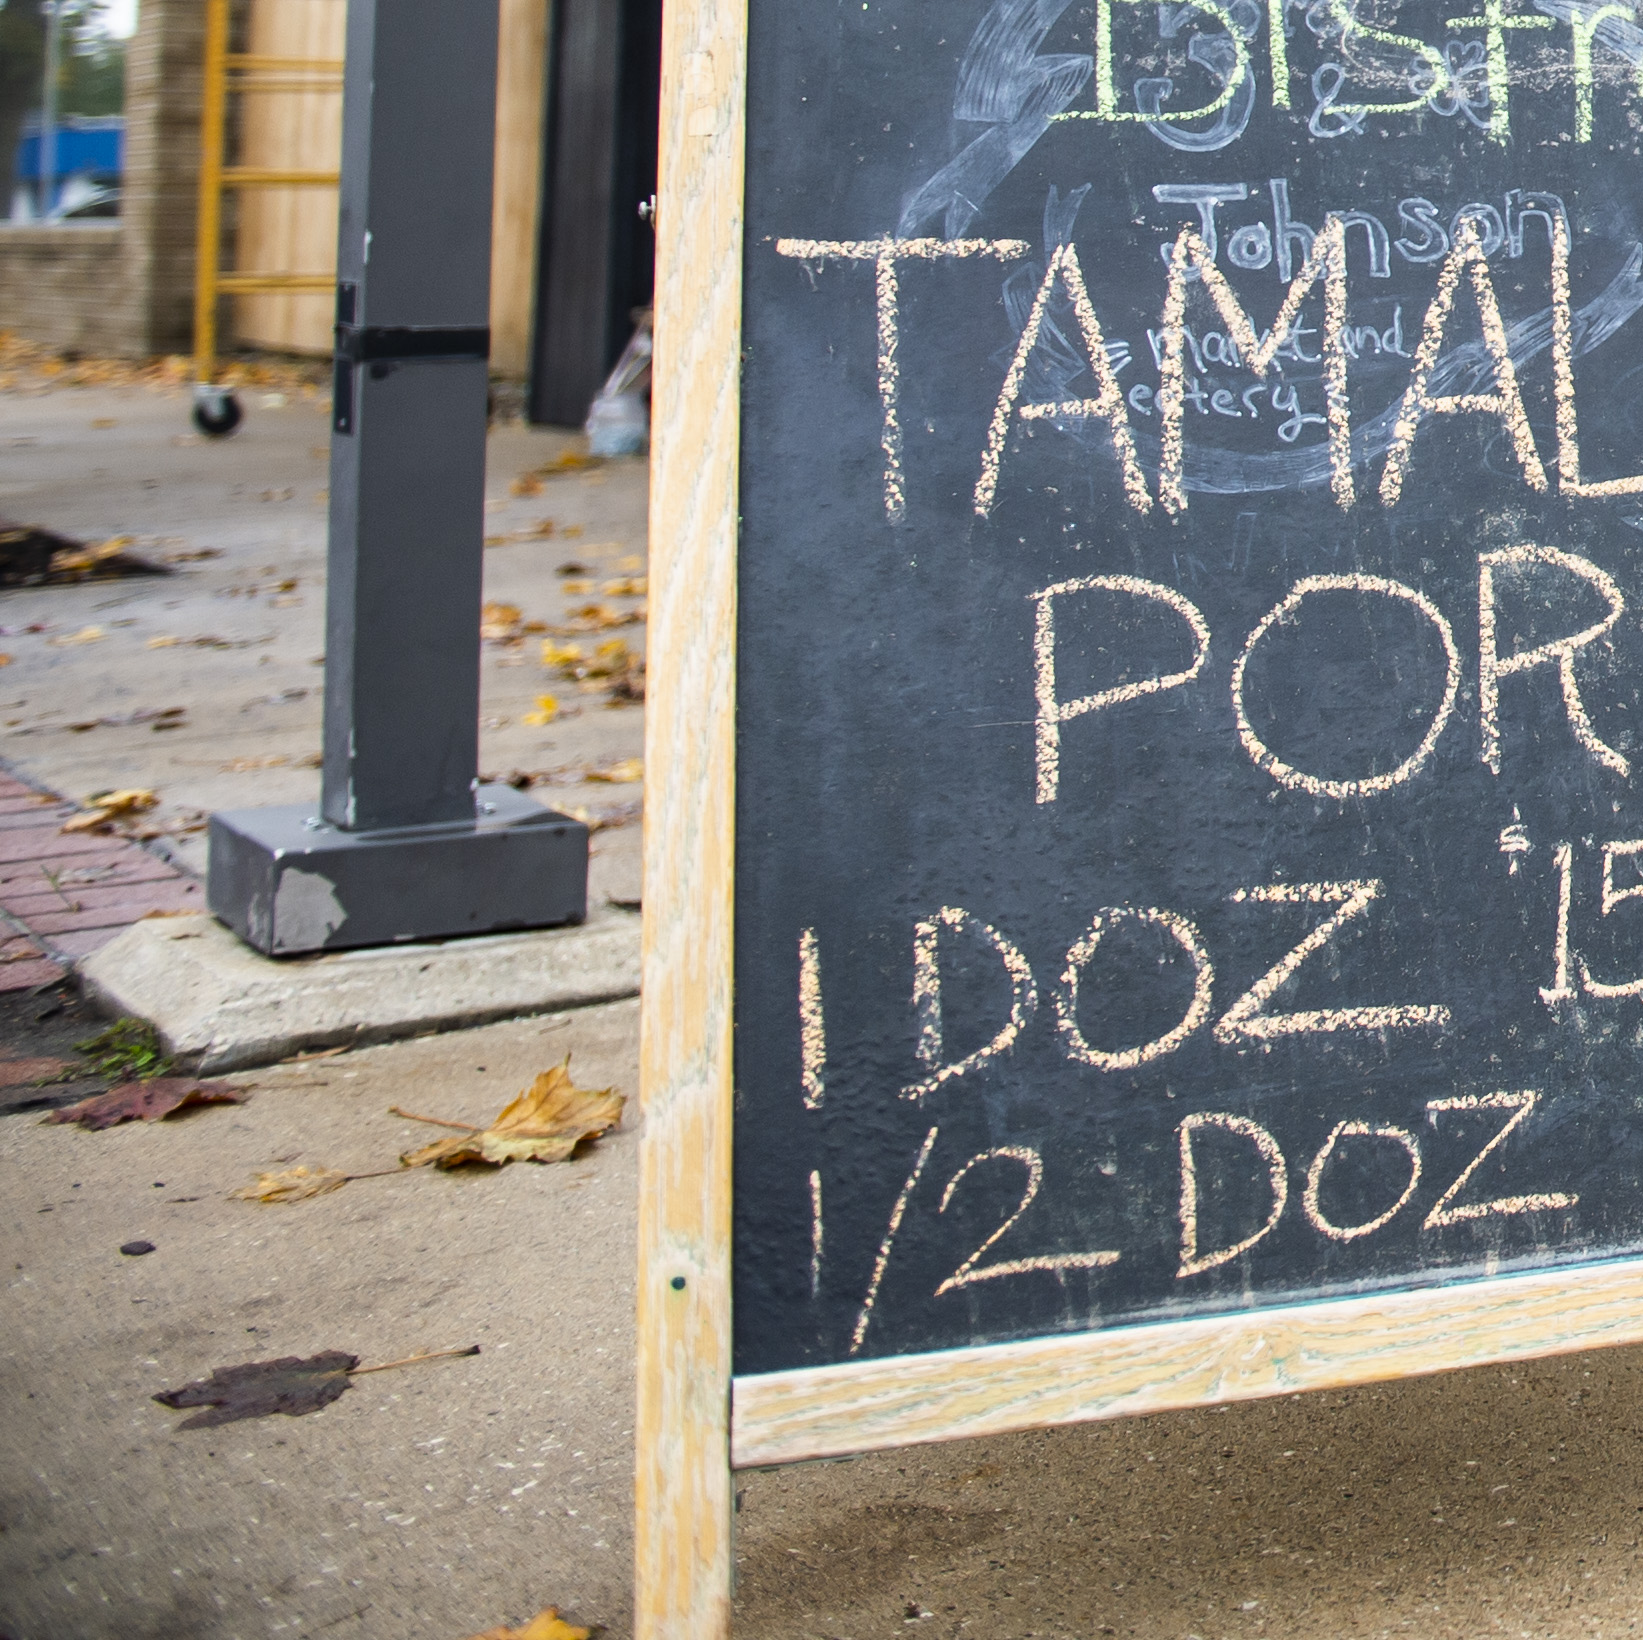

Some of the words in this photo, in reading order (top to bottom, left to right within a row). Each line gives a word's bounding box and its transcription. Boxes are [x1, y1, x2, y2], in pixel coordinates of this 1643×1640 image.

[1152, 177, 1572, 285] Johnson
[897, 877, 1453, 1104] DOZ
[810, 1124, 1123, 1357] 1/2
[1174, 1089, 1580, 1280] DOZ
